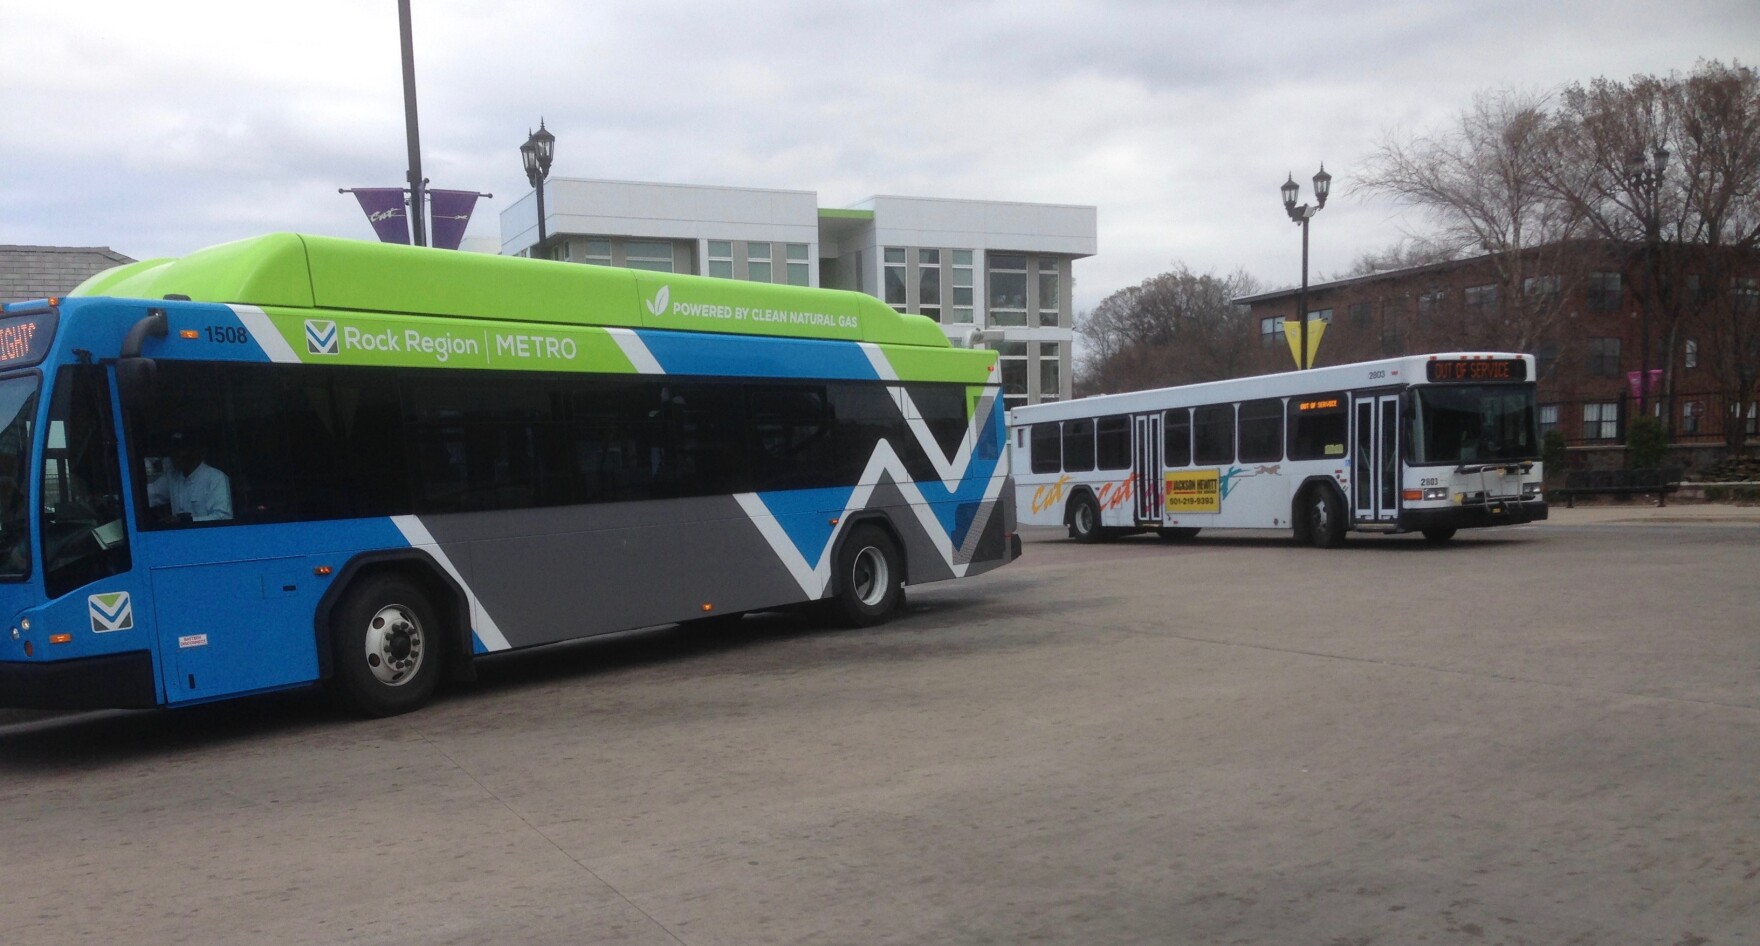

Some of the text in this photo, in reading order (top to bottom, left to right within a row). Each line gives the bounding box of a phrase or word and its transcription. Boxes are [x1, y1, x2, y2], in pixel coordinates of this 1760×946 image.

[673, 302, 858, 328] POWERED BY CLEAN NATURAL GAS
[204, 325, 248, 344] 1508
[343, 326, 577, 362] Rock Region METRO
[1368, 370, 1386, 380] 2803
[1434, 361, 1510, 379] OUT OF SERVICE
[1420, 477, 1438, 487] 2803
[1031, 475, 1072, 514] Cat
